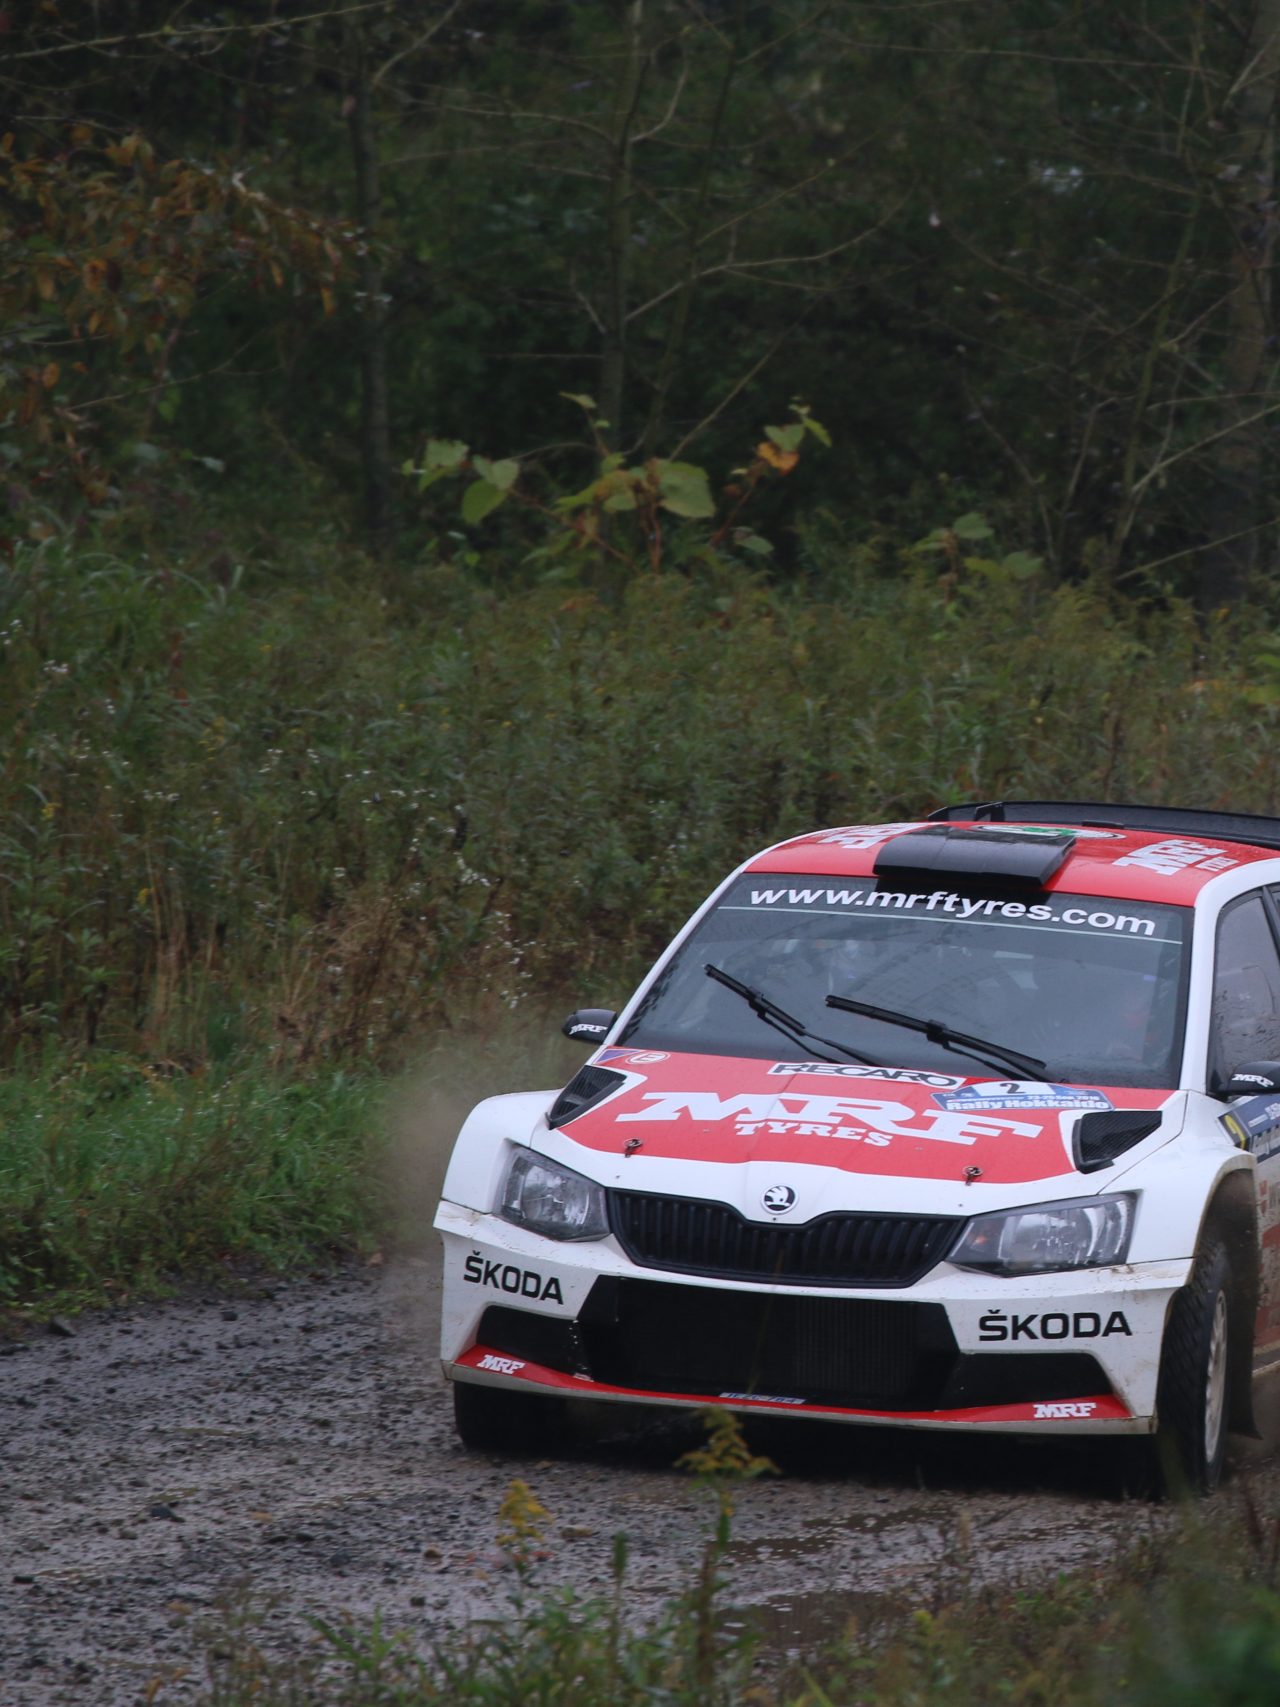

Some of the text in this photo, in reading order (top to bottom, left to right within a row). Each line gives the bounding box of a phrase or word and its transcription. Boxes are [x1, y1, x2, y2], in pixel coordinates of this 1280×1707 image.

[751, 888, 1155, 936] www.mrftyres.com
[569, 1023, 606, 1034] MRF
[773, 1063, 959, 1087] RECARO
[1232, 1073, 1274, 1087] MRF
[1000, 1083, 1025, 1094] 2
[946, 1100, 1109, 1111] Rally Hokkaido
[615, 1092, 1043, 1145] MRF
[735, 1121, 892, 1147] TYRES
[463, 1250, 564, 1306] ŠKODA
[978, 1309, 1132, 1341] ŠKODA
[476, 1354, 525, 1375] MRF
[1033, 1402, 1097, 1418] MRF
